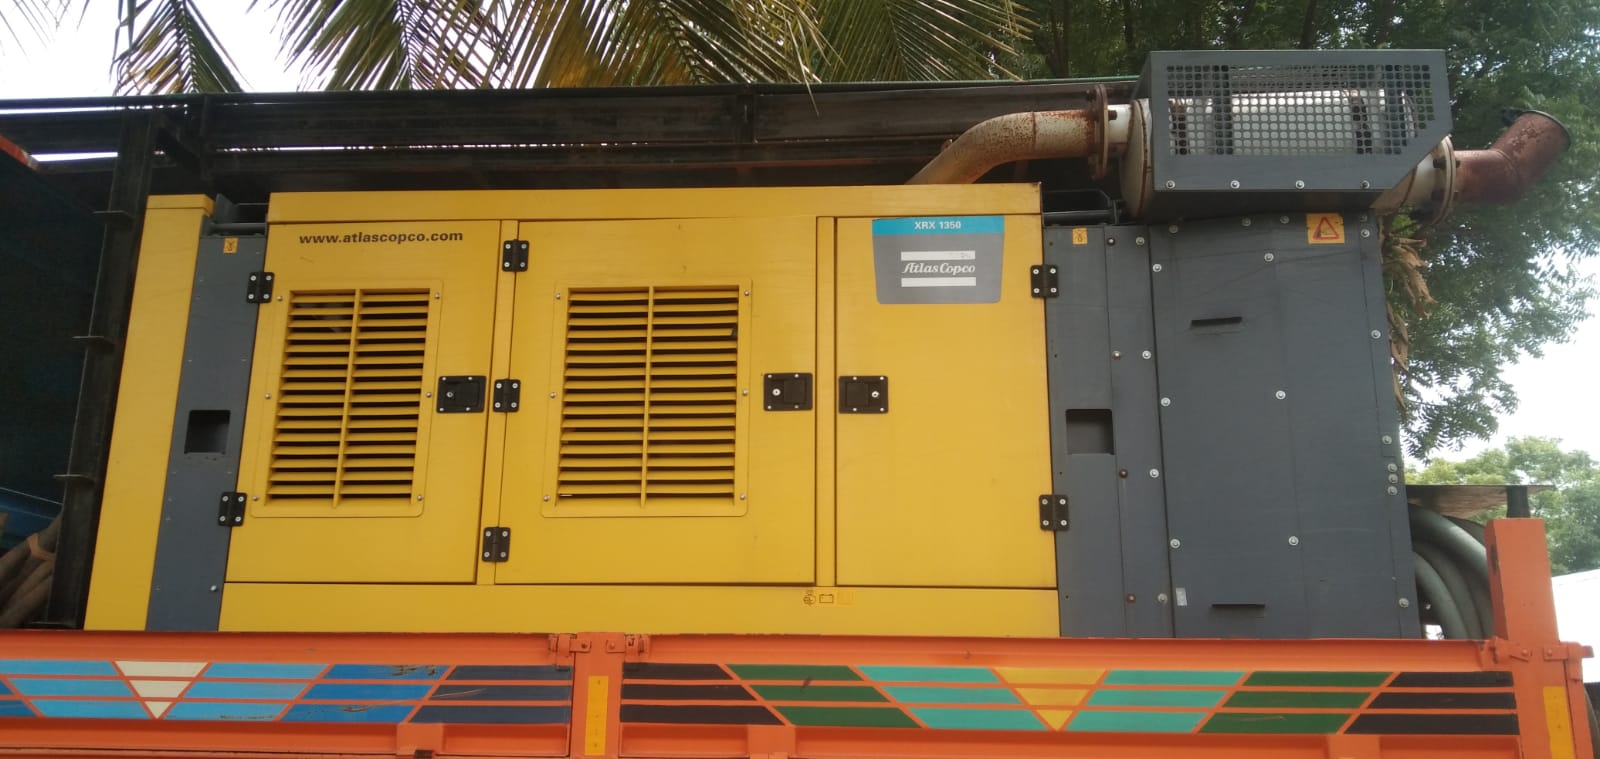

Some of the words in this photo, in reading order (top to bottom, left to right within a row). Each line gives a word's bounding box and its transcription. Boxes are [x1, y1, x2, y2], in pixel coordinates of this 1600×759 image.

[914, 221, 936, 230] XRX
[939, 220, 962, 230] 1350
[299, 231, 463, 244] www.atlascopco.com
[902, 262, 939, 274] Atlas
[939, 262, 976, 275] Copco
